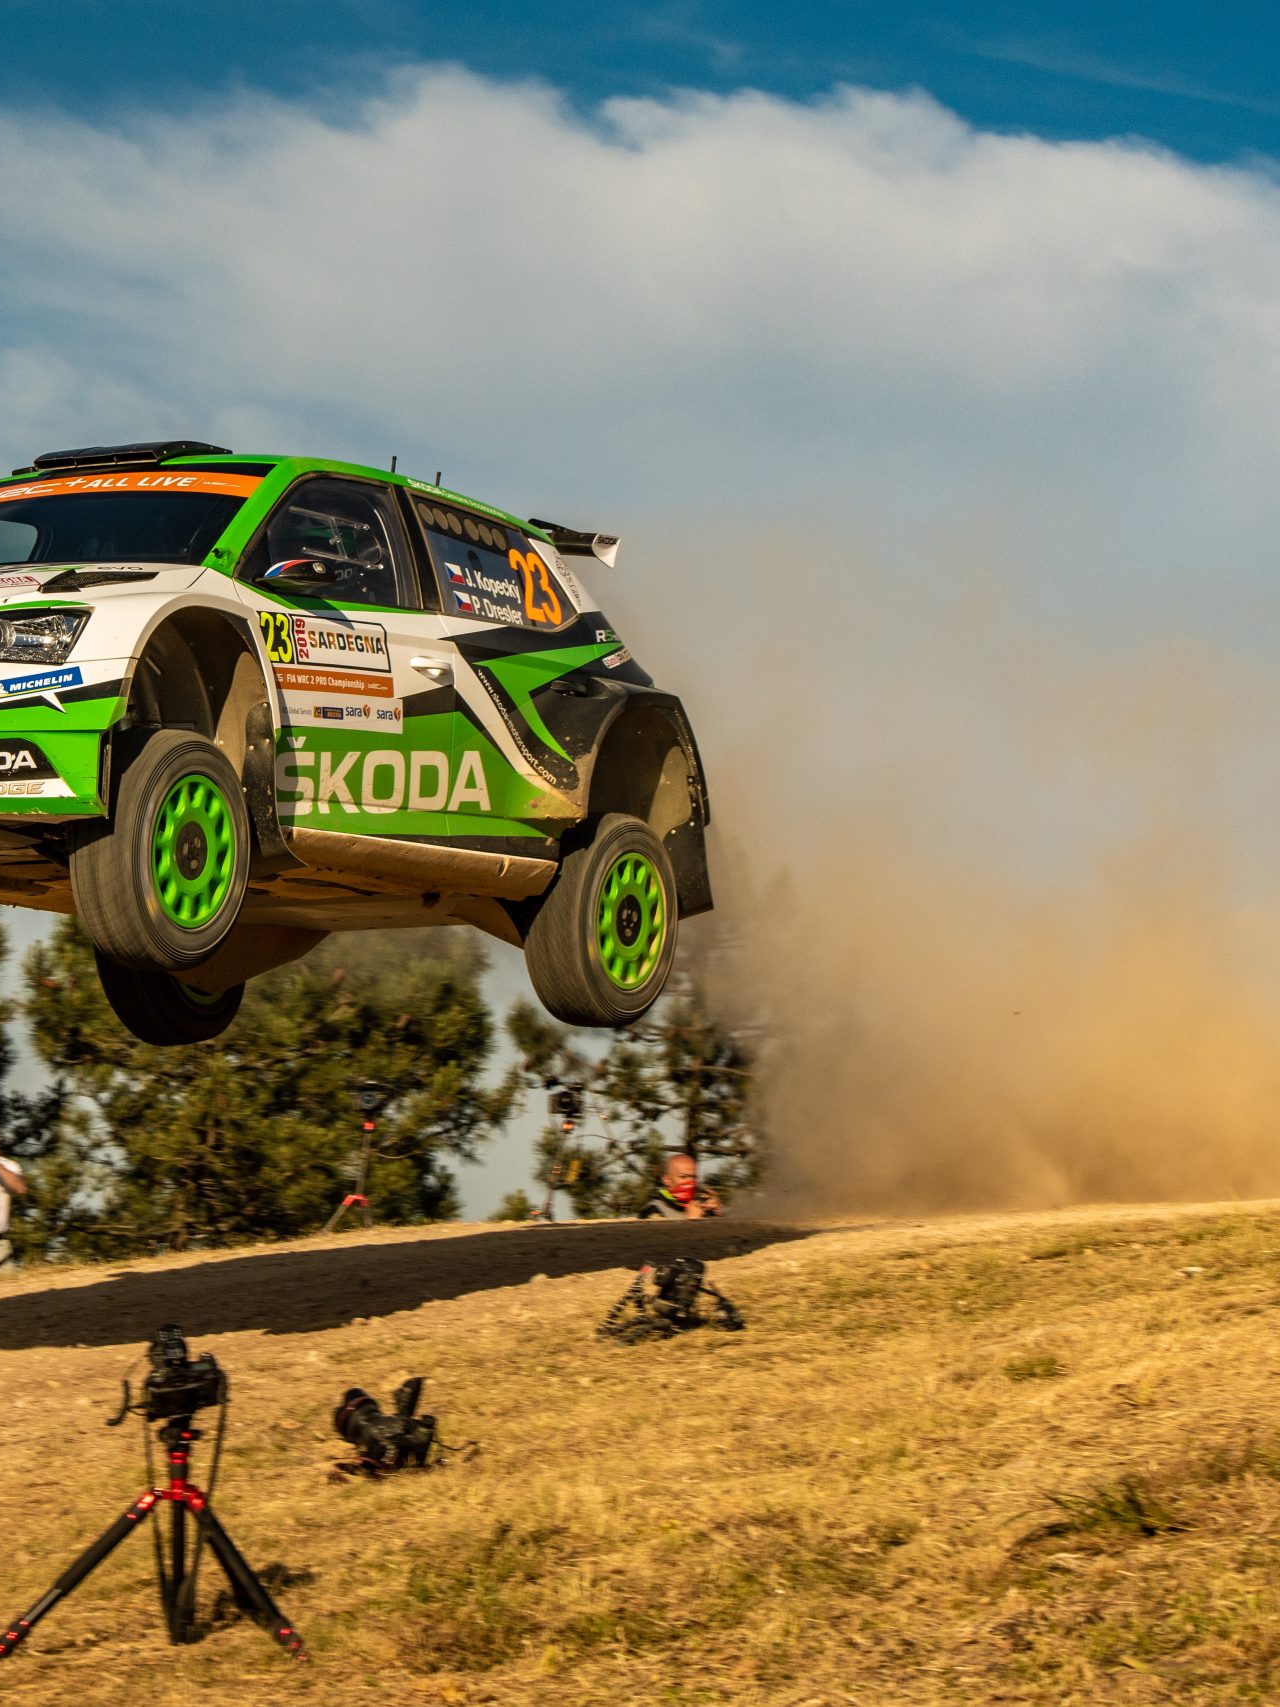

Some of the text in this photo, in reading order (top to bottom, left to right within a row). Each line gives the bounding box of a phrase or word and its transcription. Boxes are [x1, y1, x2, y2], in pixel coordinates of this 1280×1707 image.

[83, 477, 130, 488] ALL
[136, 476, 198, 488] LIVE
[465, 568, 520, 604] J. Kopecký
[508, 548, 562, 626] 23
[472, 595, 523, 625] P. Dresler
[260, 611, 293, 663] 23
[294, 618, 309, 659] 2019
[308, 631, 386, 655] SARDEGNA
[9, 673, 73, 692] MICHELIN
[286, 674, 296, 683] FIA
[297, 675, 310, 684] WRC
[310, 676, 315, 685] 2
[316, 677, 327, 686] PRO
[328, 678, 365, 691] Championship
[345, 706, 362, 717] sara
[376, 709, 393, 720] sara
[478, 669, 557, 785] www.skoda-motorsport.com
[276, 736, 492, 817] ŠKODA
